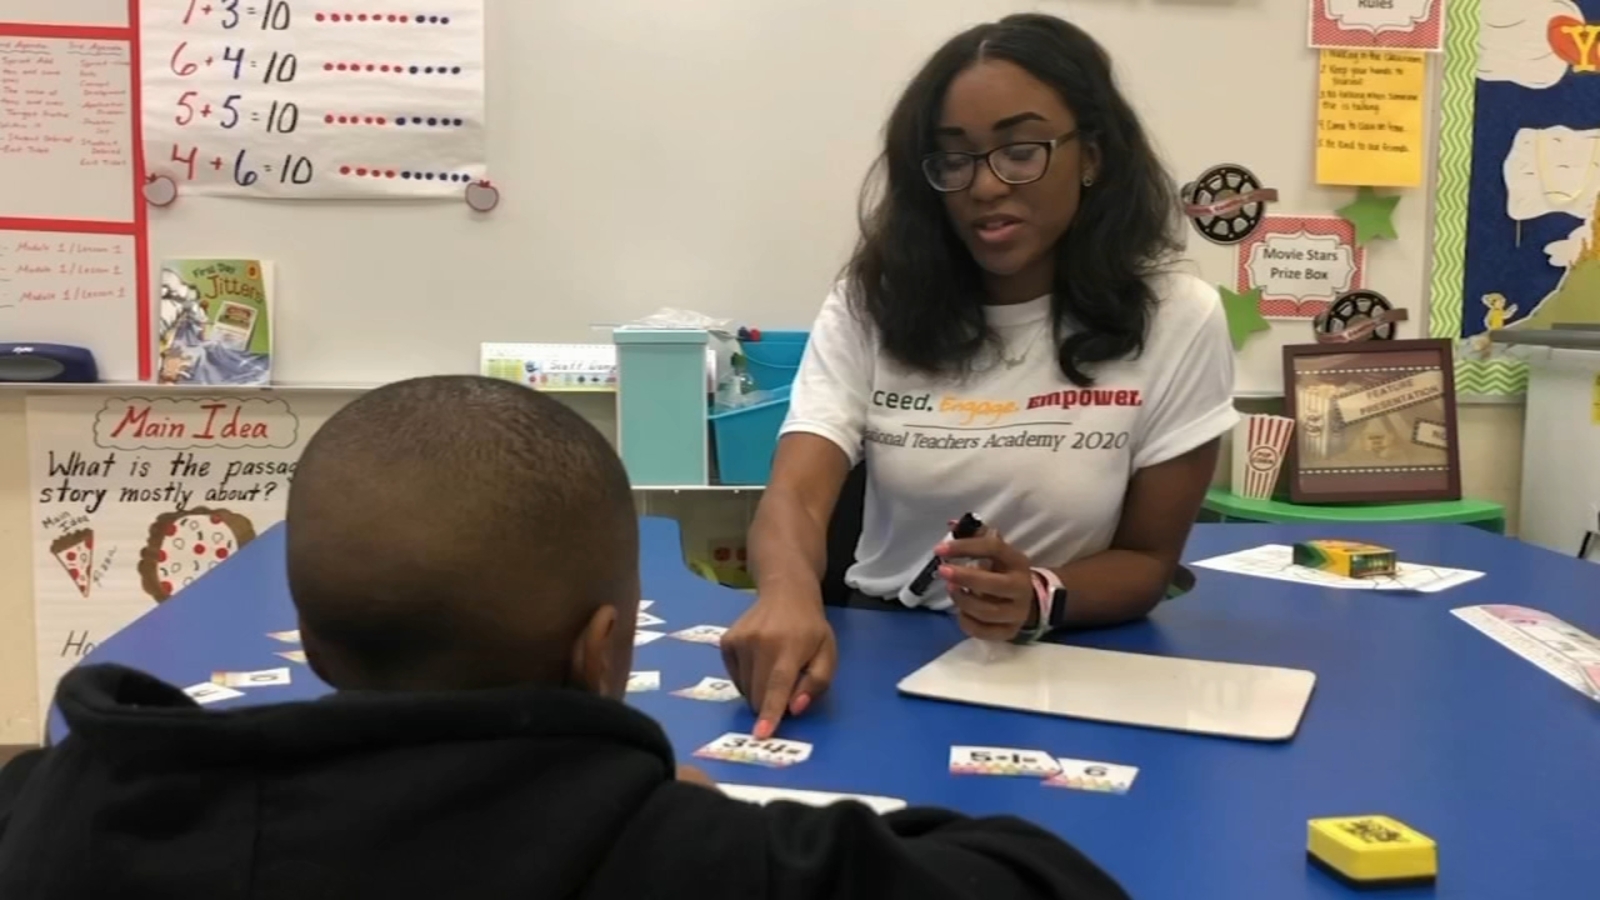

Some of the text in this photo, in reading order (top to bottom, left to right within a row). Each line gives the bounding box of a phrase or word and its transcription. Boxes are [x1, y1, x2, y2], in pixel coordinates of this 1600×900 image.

[1561, 25, 1600, 73] Y
[1263, 248, 1338, 262] Movie Stars
[1270, 267, 1329, 280] Prize Box
[110, 403, 269, 440] Main Idea
[911, 432, 980, 450] Teachers
[981, 430, 1066, 453] Academy
[1070, 430, 1130, 450] 2020
[48, 450, 115, 478] What
[170, 451, 211, 478] the
[39, 478, 107, 514] story
[119, 482, 193, 511] mostly
